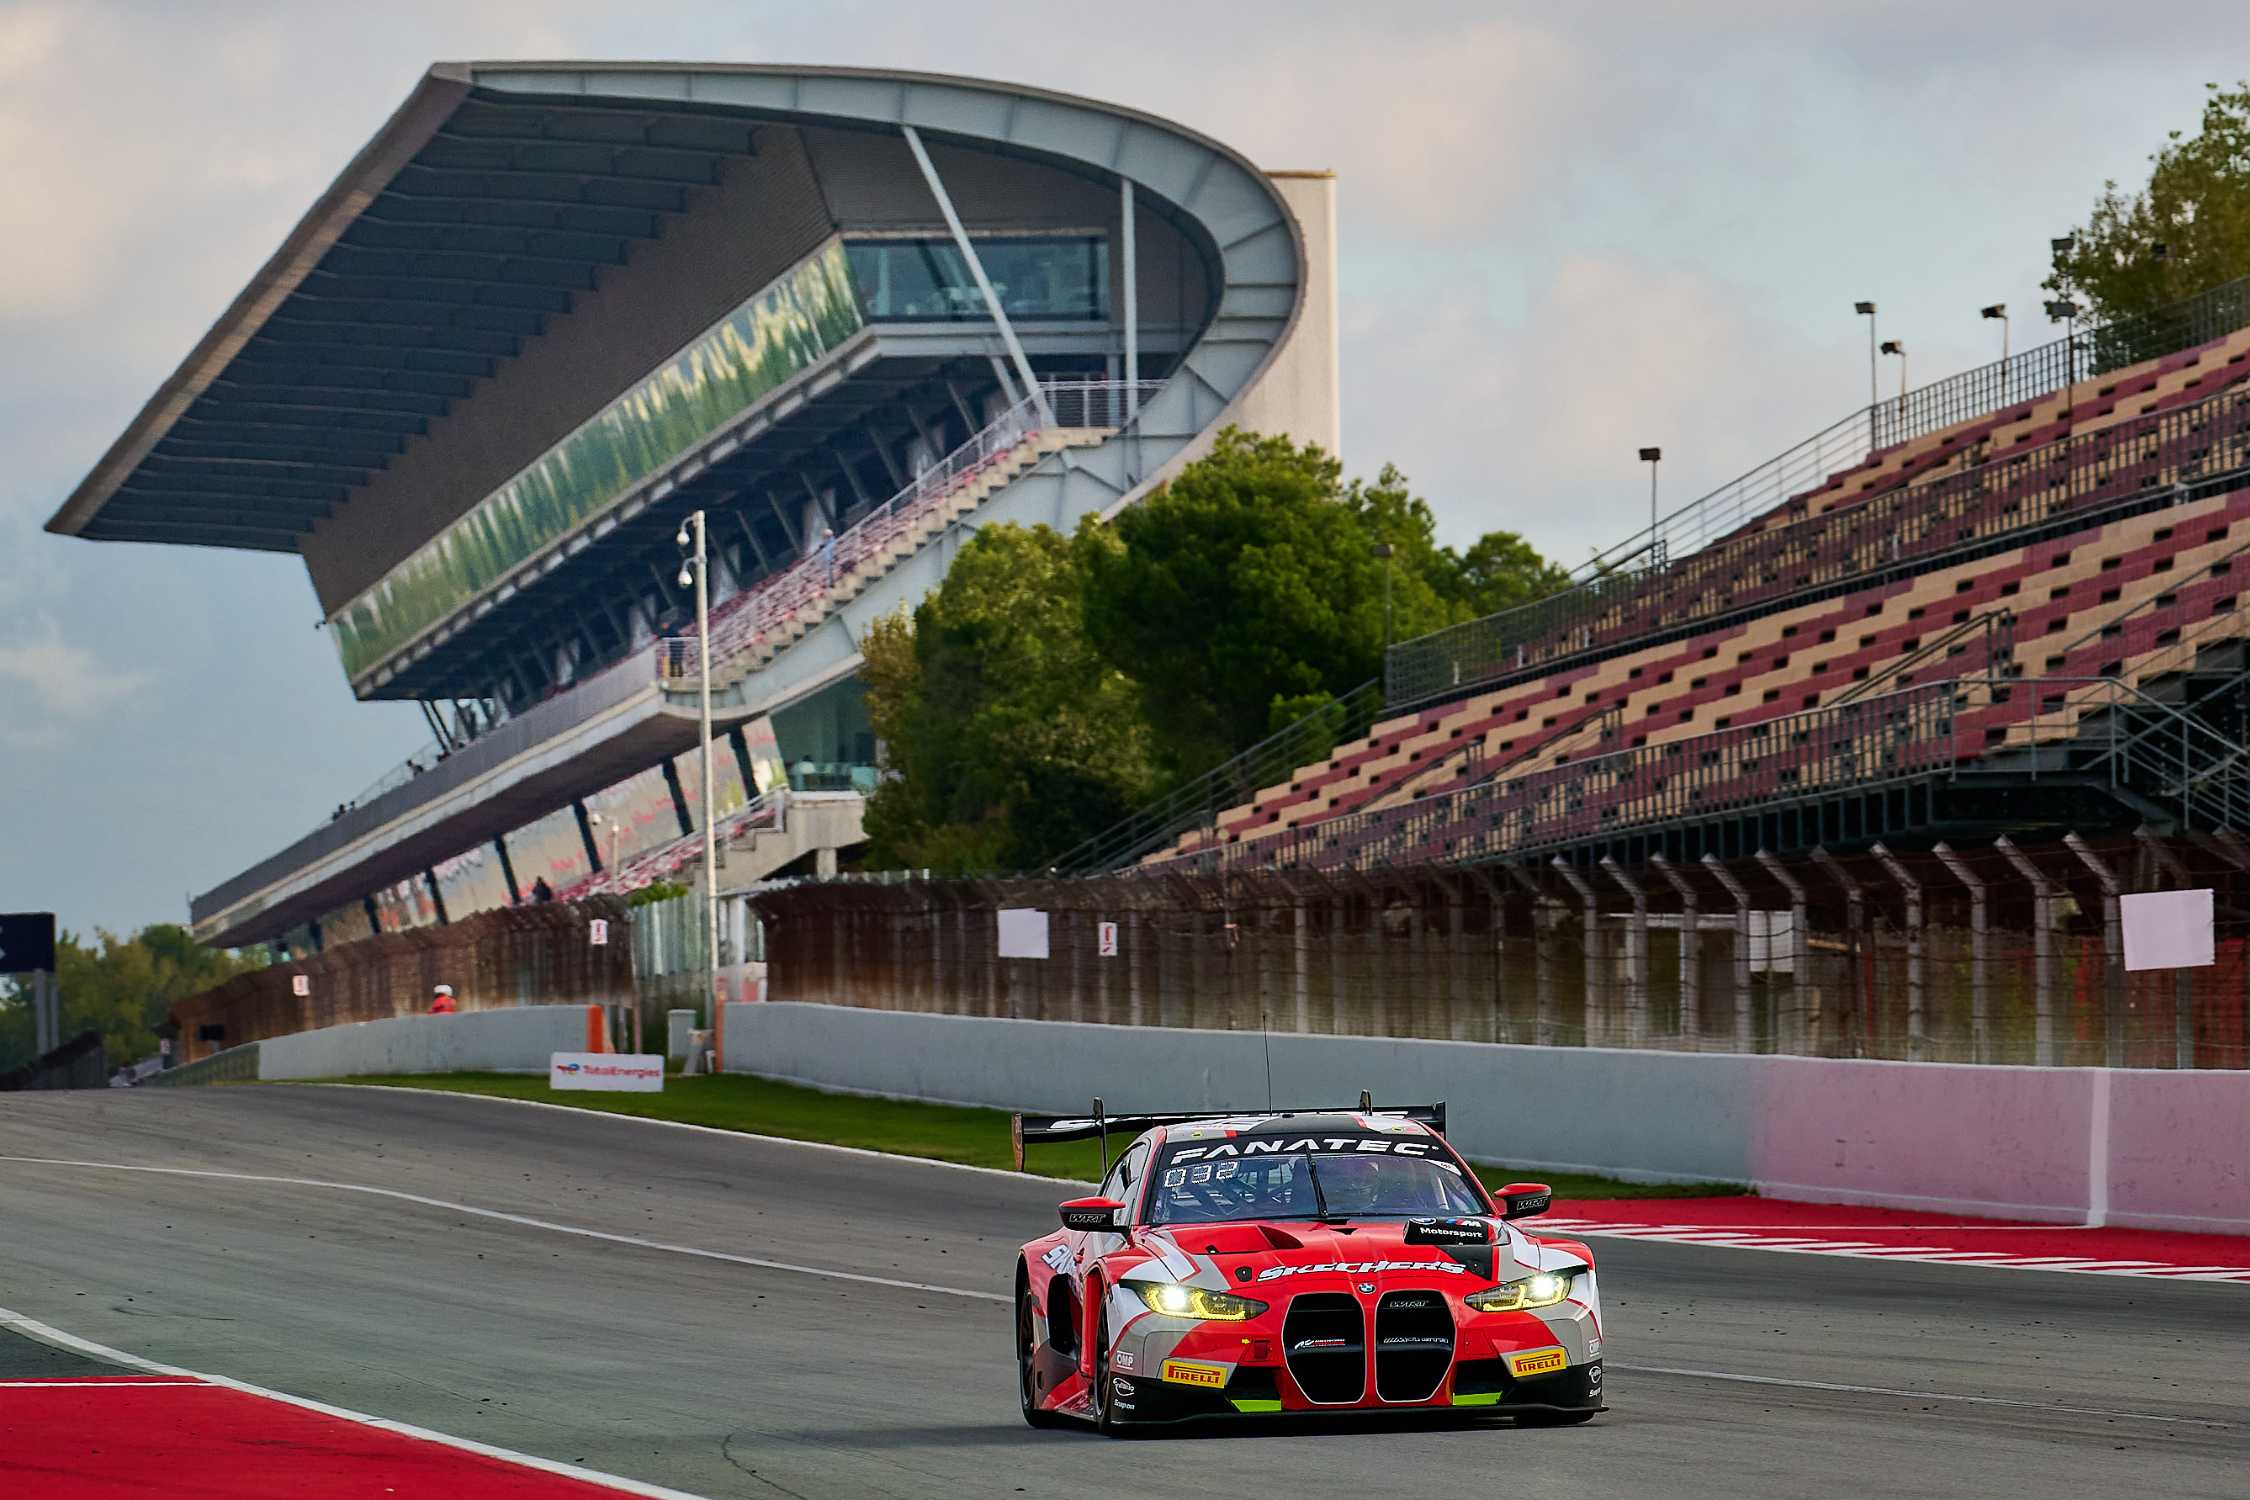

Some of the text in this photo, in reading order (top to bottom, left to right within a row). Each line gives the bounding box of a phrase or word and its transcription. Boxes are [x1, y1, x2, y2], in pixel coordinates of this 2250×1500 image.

[1171, 1138, 1429, 1164] FANATEC
[1069, 1213, 1107, 1224] WRT
[1420, 1227, 1483, 1238] Motorsport
[1257, 1261, 1466, 1282] SKECHERS
[1515, 1353, 1561, 1372] PIRELLI
[1168, 1365, 1221, 1385] PIRELLI
